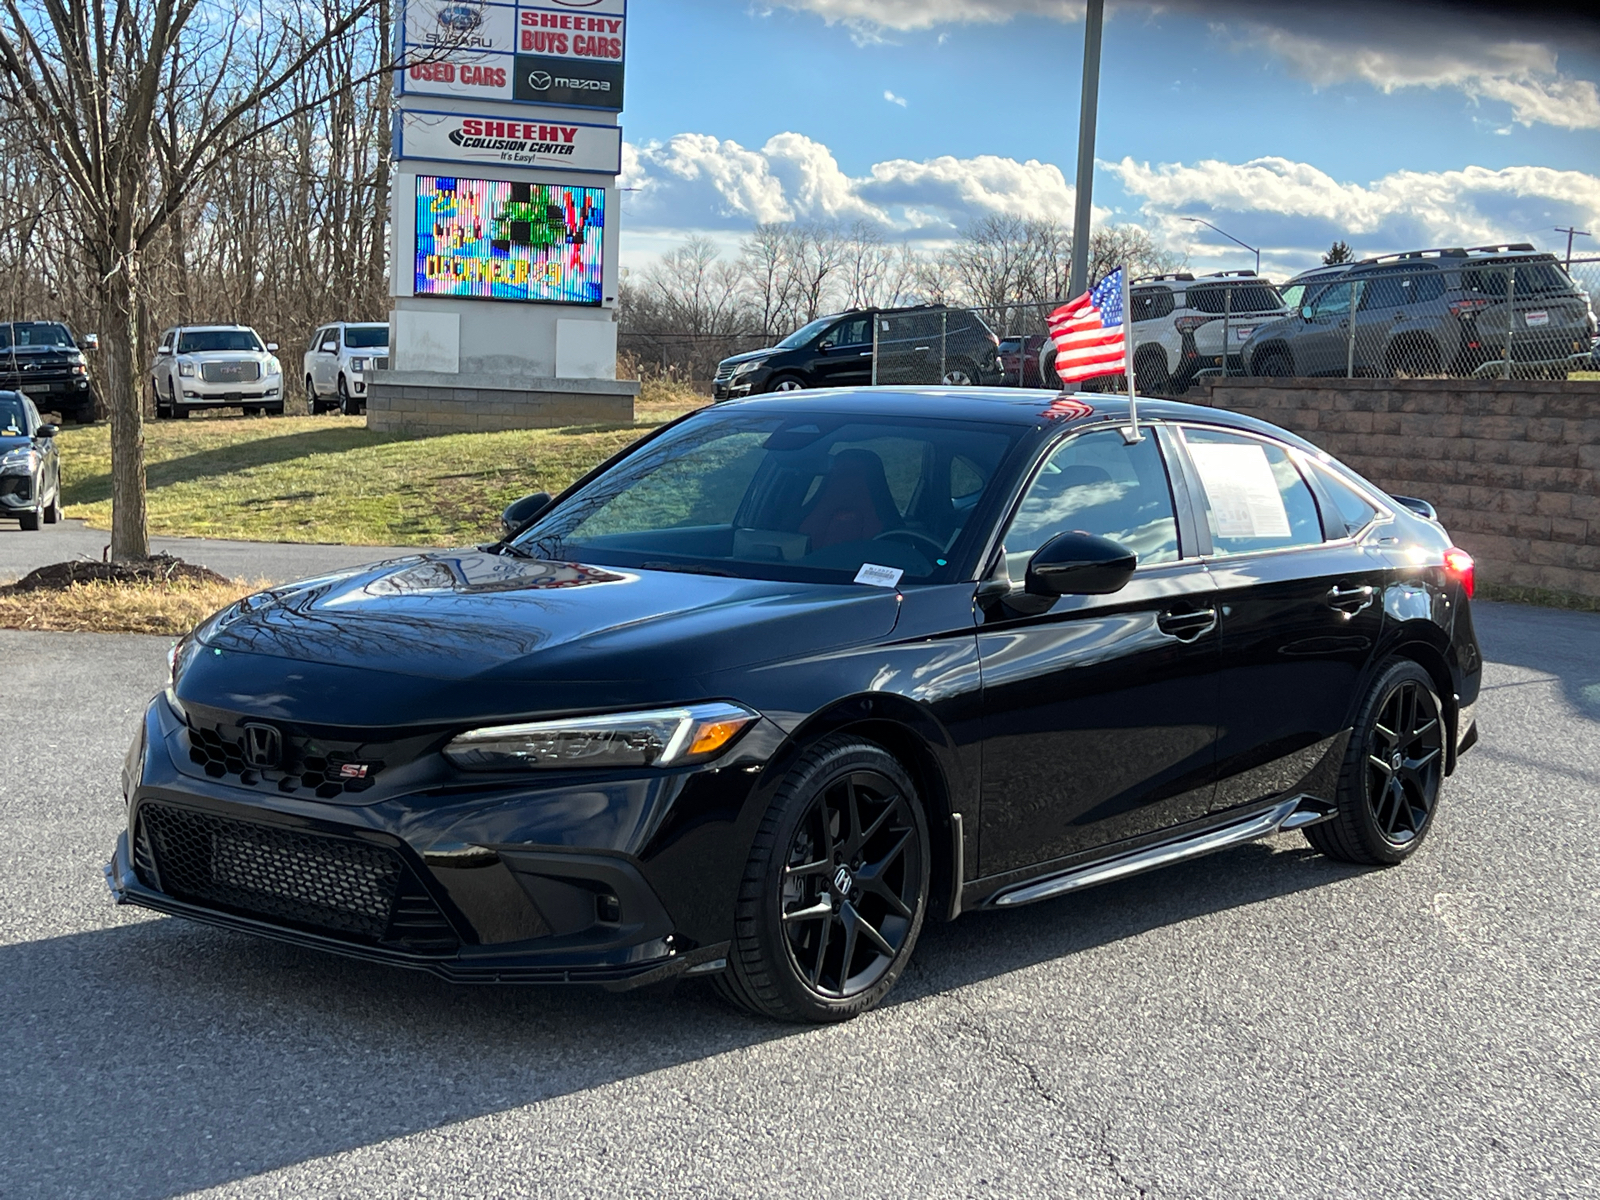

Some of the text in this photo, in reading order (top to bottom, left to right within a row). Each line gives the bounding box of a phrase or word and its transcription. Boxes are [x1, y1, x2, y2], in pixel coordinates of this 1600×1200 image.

[521, 12, 622, 33] SHEEHY
[425, 33, 492, 47] SUBARU
[521, 29, 621, 58] BUYS CARS
[410, 61, 507, 87] USED CARS
[462, 119, 578, 143] SHEEHY
[462, 137, 575, 155] COLLISION CENTER
[500, 151, 536, 164] It's Easy!
